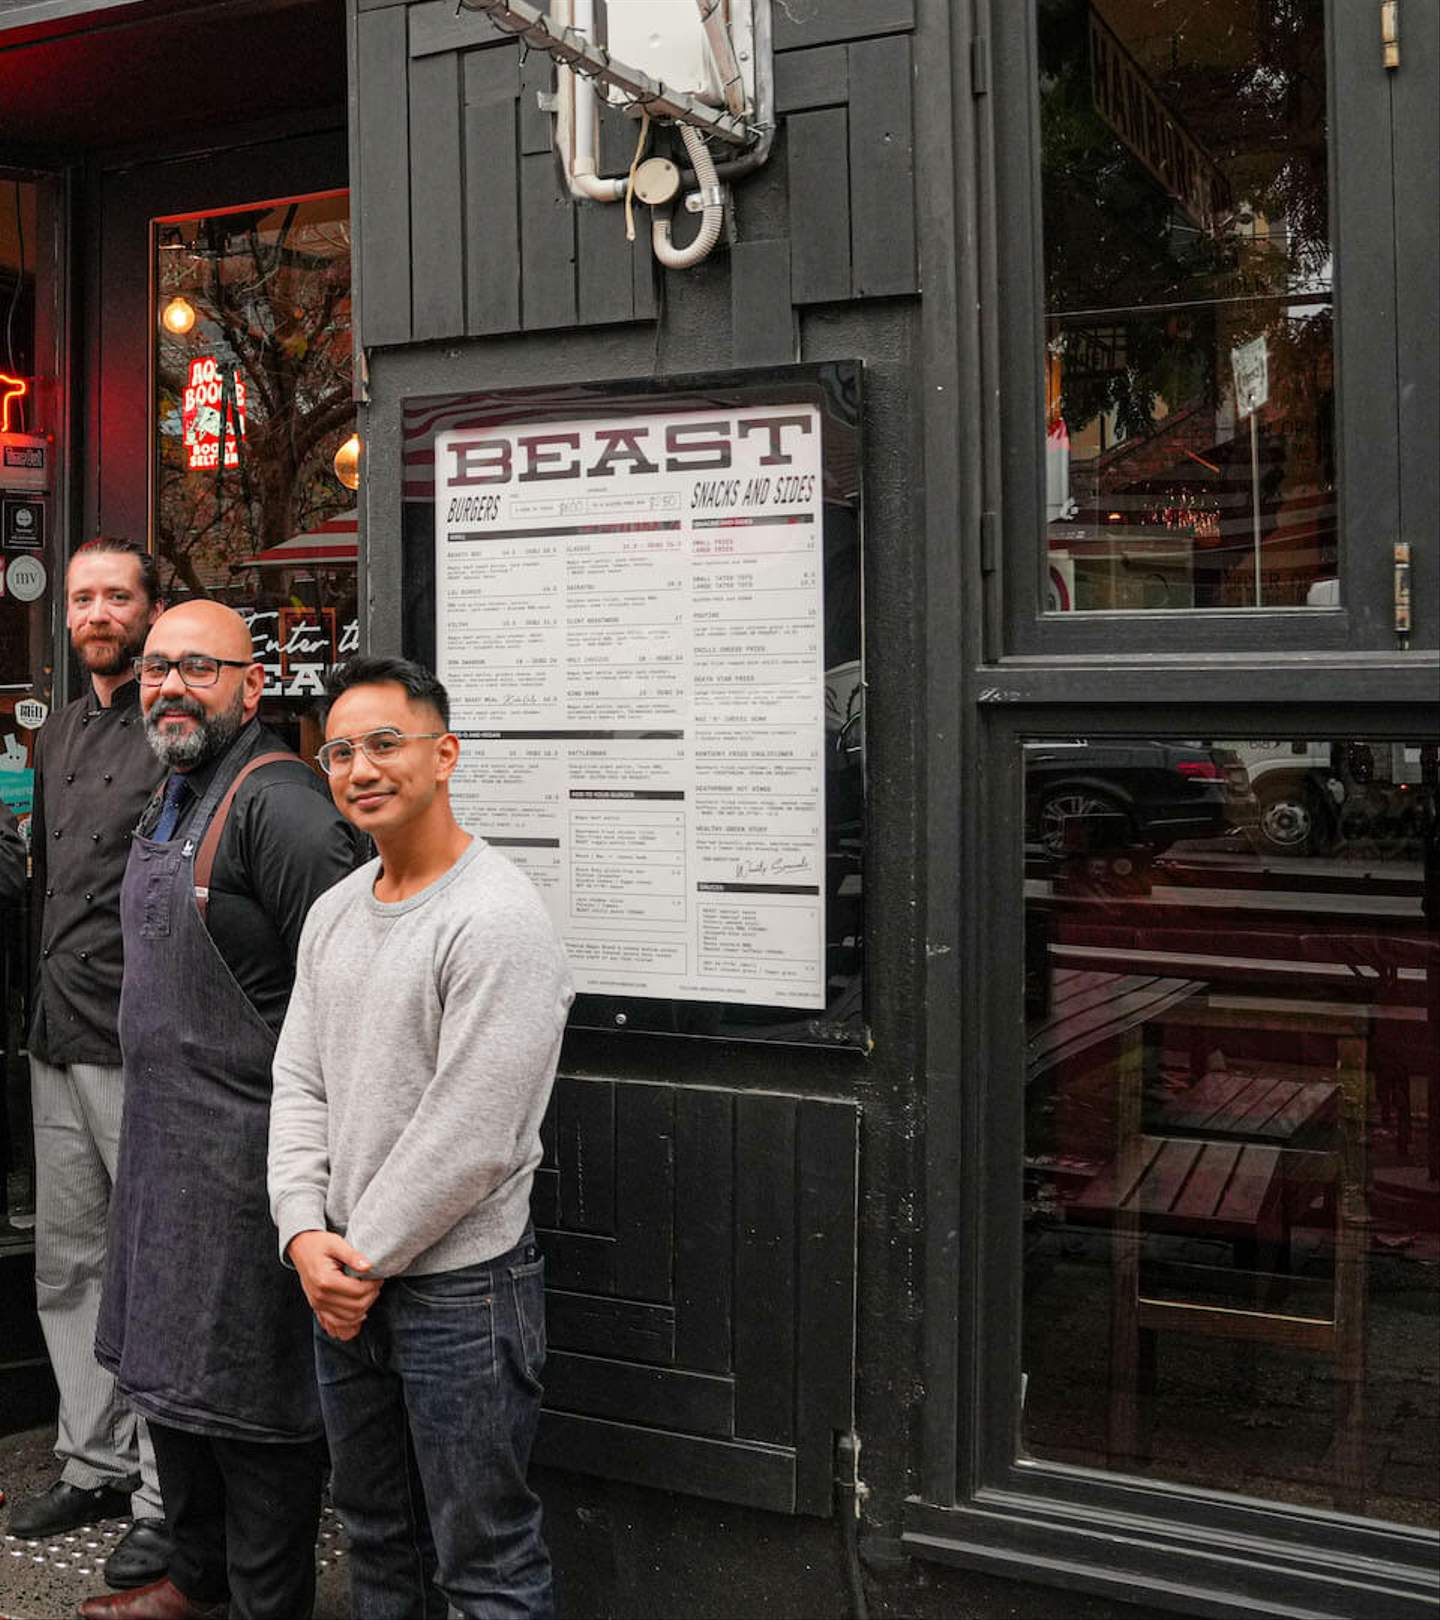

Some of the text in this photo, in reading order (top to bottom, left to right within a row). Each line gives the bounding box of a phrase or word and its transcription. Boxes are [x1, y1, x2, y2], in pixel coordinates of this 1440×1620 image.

[190, 453, 238, 467] SELTER
[193, 442, 237, 455] BOOY
[447, 415, 813, 487] BEAST
[691, 480, 740, 508] SNACKS
[742, 478, 770, 505] AND
[774, 474, 815, 504] SIDES
[447, 495, 501, 523] BURGERS
